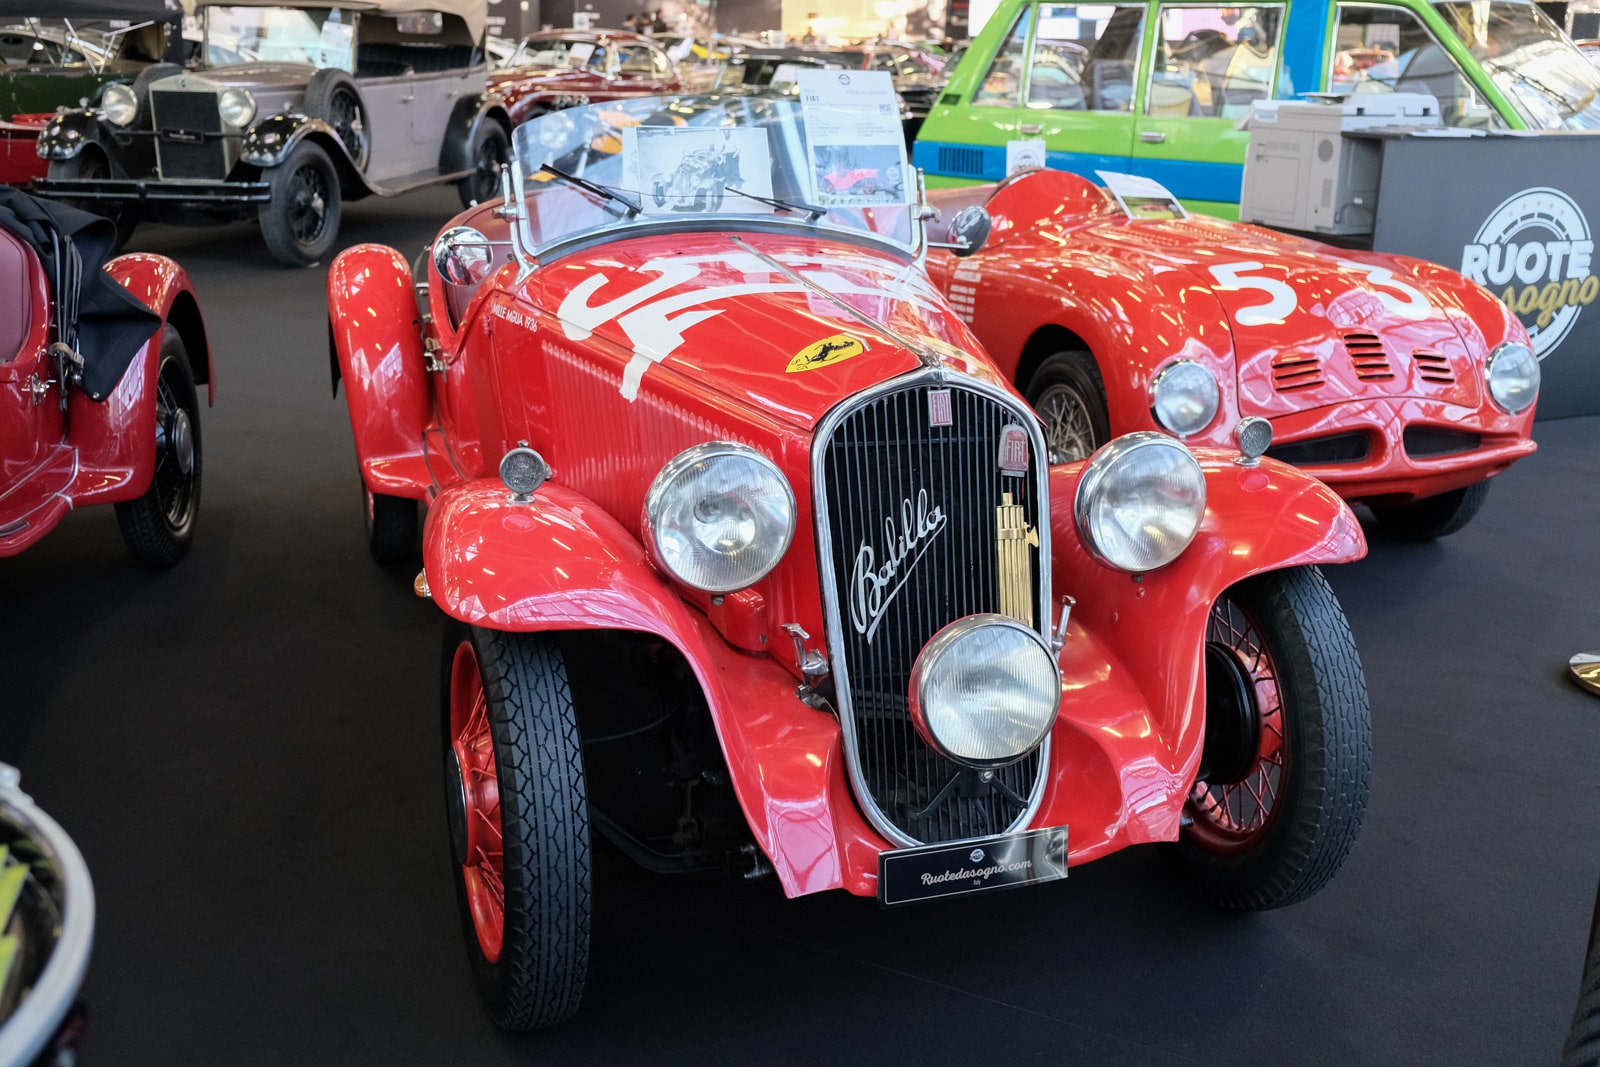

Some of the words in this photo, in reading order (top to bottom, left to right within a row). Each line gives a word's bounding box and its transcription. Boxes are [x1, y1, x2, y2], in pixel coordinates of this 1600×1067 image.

[1461, 240, 1594, 286] RUOTE
[493, 302, 507, 319] MILLE
[525, 316, 538, 332] 1936
[1501, 275, 1600, 329] sogno
[931, 392, 952, 424] FIAT
[1006, 440, 1026, 463] FIAT
[851, 489, 947, 645] Balilla
[921, 860, 1032, 885] Ruotedasogno.com
